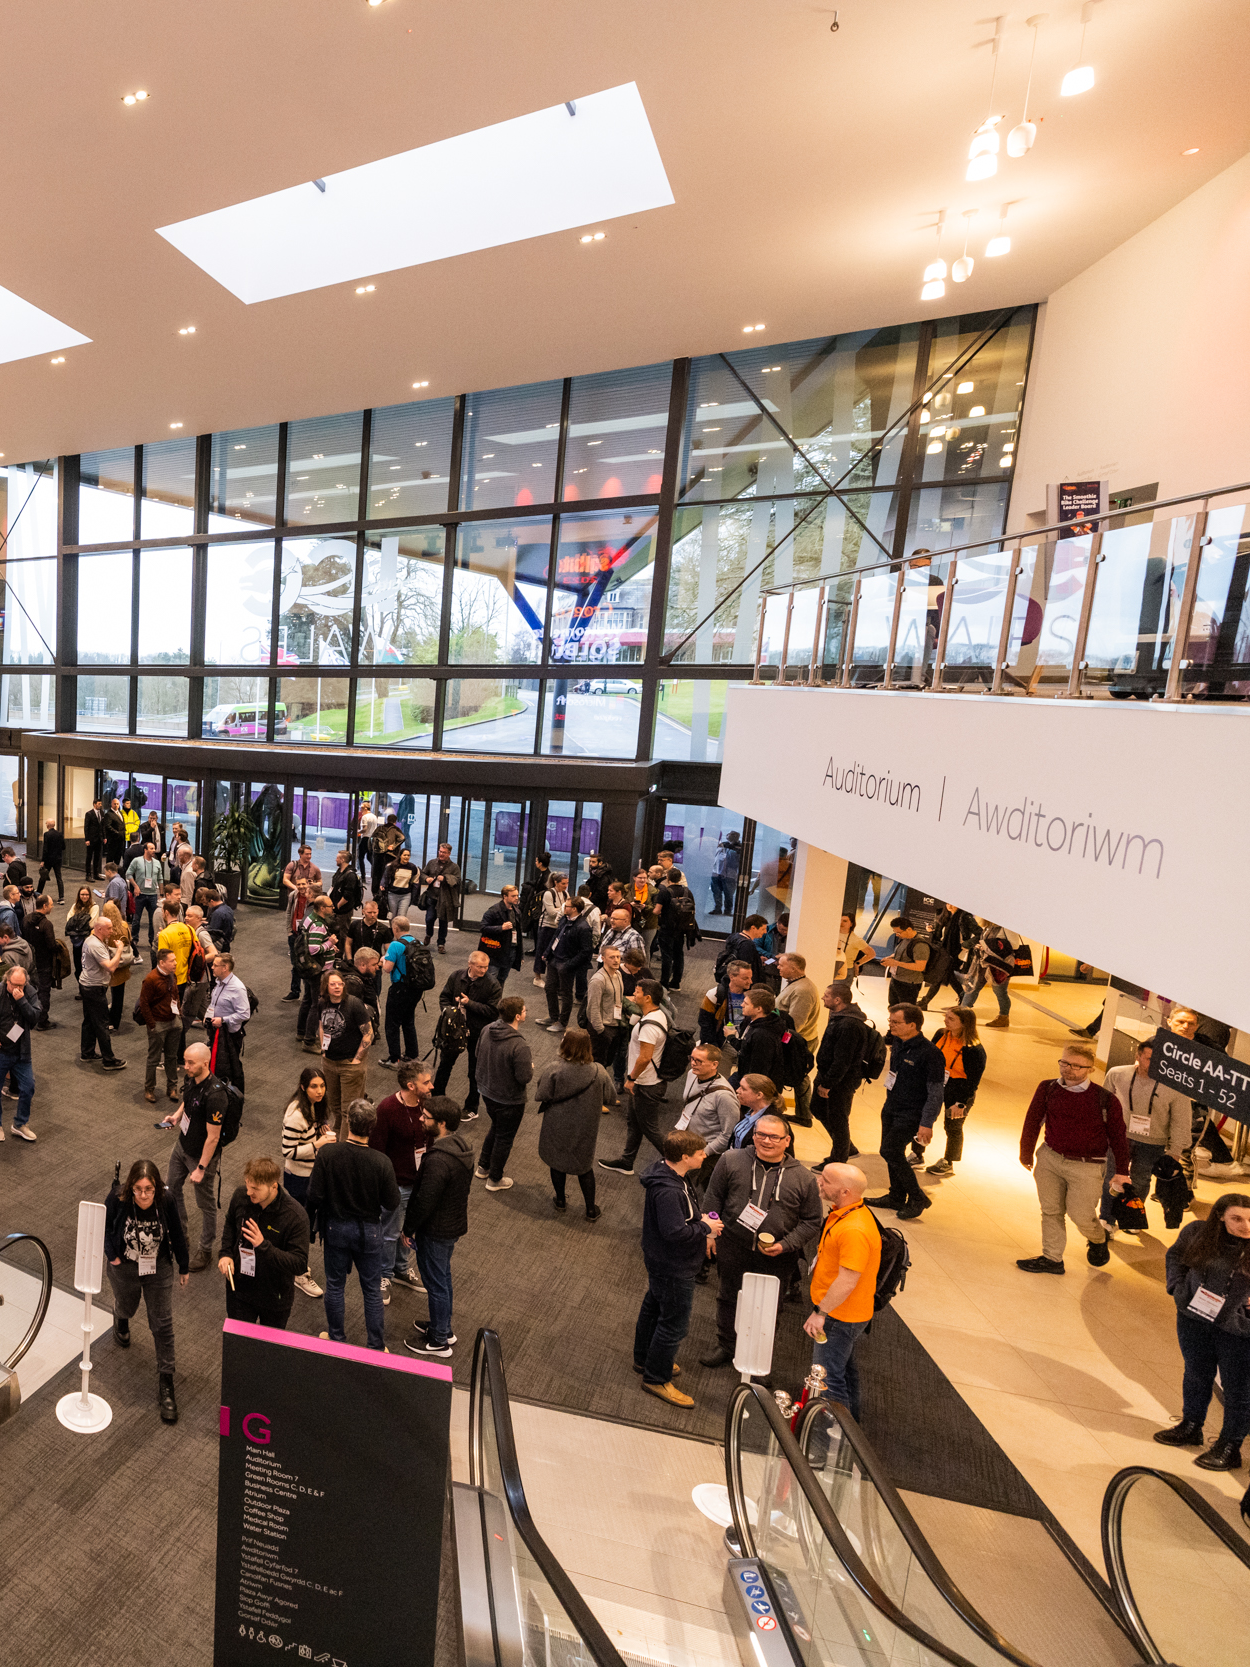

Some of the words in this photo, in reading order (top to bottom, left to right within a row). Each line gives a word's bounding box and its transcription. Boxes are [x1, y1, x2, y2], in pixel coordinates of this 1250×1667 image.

[822, 756, 921, 812] Auditorium
[962, 786, 1164, 879] Awditoriwm
[1162, 1041, 1202, 1070] Circle
[1202, 1060, 1250, 1092] AA-TT
[1158, 1060, 1194, 1088] Seats
[1197, 1079, 1205, 1094] 1
[1217, 1088, 1237, 1109] 52
[242, 1412, 272, 1445] G
[246, 1445, 261, 1455] Main
[263, 1450, 275, 1458] Hall
[245, 1454, 282, 1468] Auditorium
[245, 1463, 272, 1476] Meeting
[273, 1470, 293, 1480] Room
[244, 1480, 273, 1493] Business
[274, 1488, 297, 1499] Centre
[245, 1471, 265, 1482] Green
[266, 1477, 289, 1488] Rooms
[313, 1489, 319, 1497] &
[244, 1488, 267, 1500] Atrium
[243, 1505, 266, 1517] Coffee
[267, 1512, 284, 1522] Shop
[244, 1497, 272, 1509] Outdoor
[273, 1505, 290, 1515] Plaza
[243, 1514, 268, 1526] Medical
[268, 1521, 289, 1532] Room
[243, 1522, 262, 1533] Water
[263, 1528, 287, 1540] Station
[241, 1535, 253, 1543] Prif
[253, 1539, 279, 1552] Neuadd
[241, 1544, 279, 1560] Awditoriwm
[264, 1560, 293, 1573] Cyfarfod
[239, 1577, 263, 1590] Atriwm
[240, 1569, 269, 1583] Canolfan
[269, 1578, 293, 1591] Fusnes
[280, 1573, 306, 1586] Gwyrdd
[239, 1586, 256, 1596] Plaza
[256, 1592, 273, 1601] Awyr
[274, 1597, 298, 1609] Agored
[239, 1594, 253, 1603] Siop
[238, 1610, 260, 1622] Gorsaf
[262, 1609, 291, 1624] Feddygol
